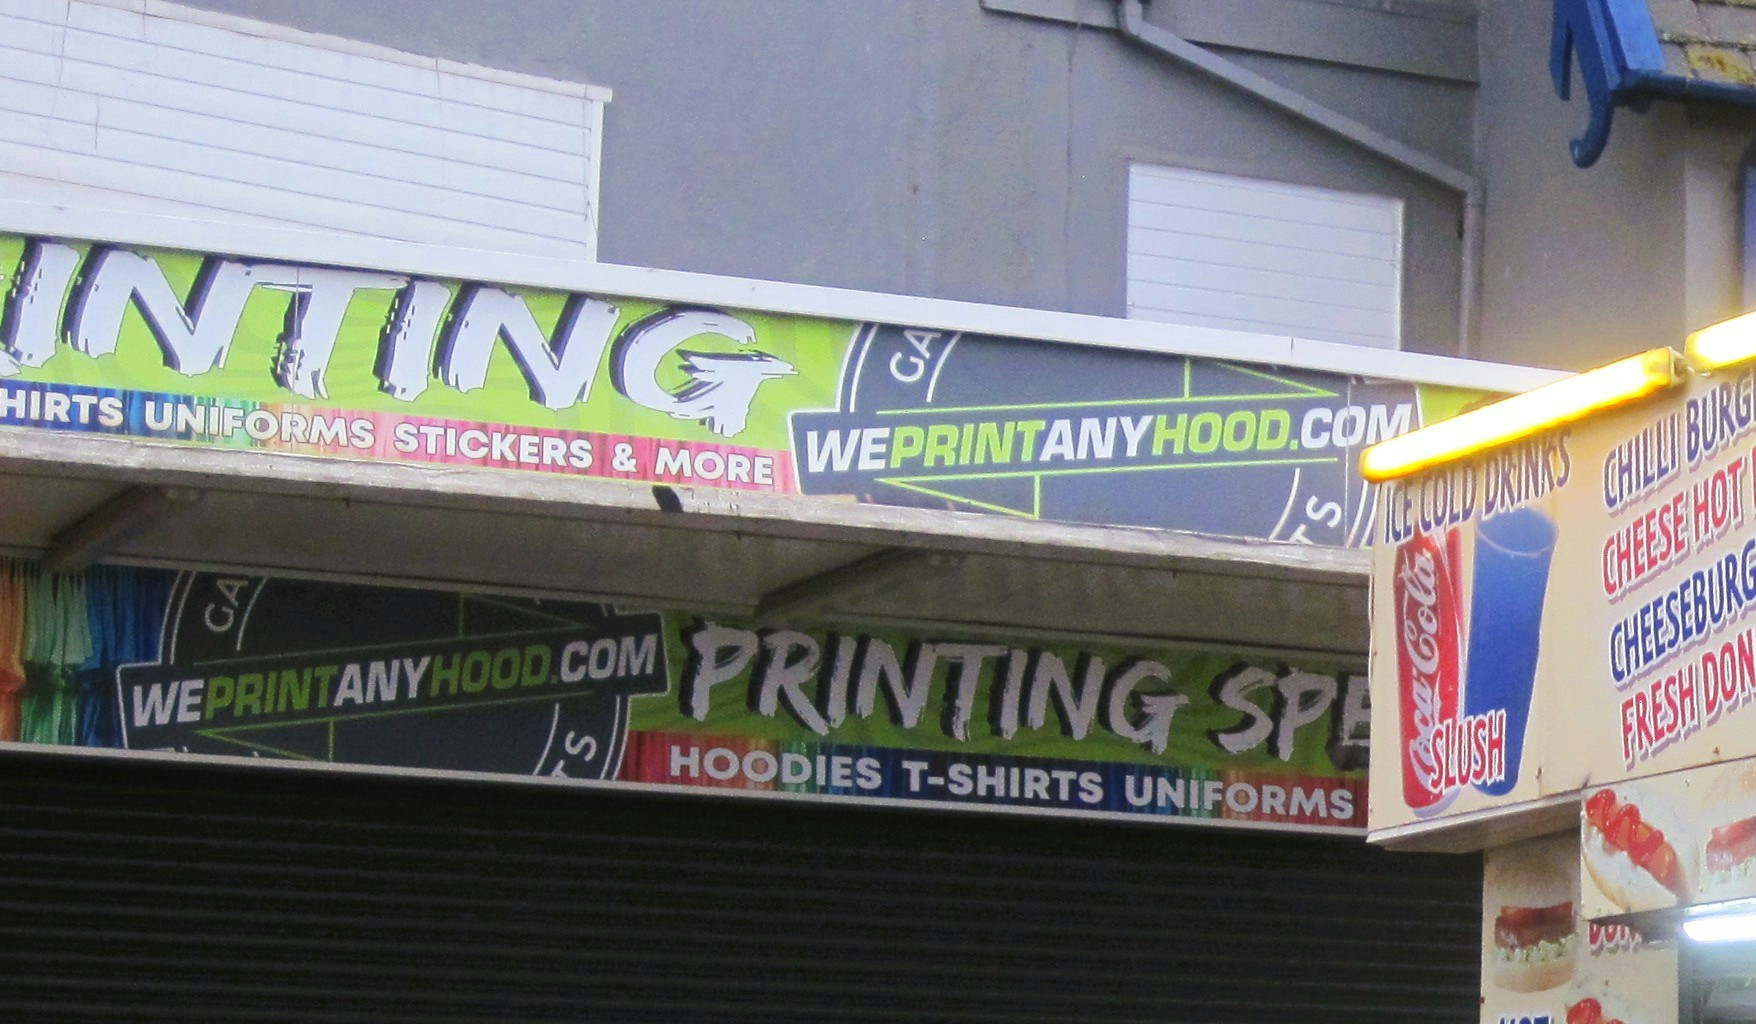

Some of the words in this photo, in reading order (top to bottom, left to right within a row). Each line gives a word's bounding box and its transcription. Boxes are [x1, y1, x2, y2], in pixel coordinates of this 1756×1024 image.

[0, 237, 797, 437] INTING
[145, 401, 376, 450] UNIFORMS
[394, 425, 593, 470] STICKERS
[612, 443, 638, 472] &
[654, 449, 775, 485] MORE
[805, 403, 1411, 474] WEPRINTANYHOOD.COM
[1384, 482, 1414, 545] ICE
[1418, 460, 1477, 533] COLD
[1483, 427, 1571, 517] DRINKS
[1603, 413, 1680, 508] CHILLI
[1602, 498, 1688, 597] CHEESE
[1693, 460, 1747, 540] HOT
[132, 634, 658, 728] WEPRINTANYHOOD.COM
[690, 619, 1189, 756] PRINTING
[1621, 665, 1697, 763] FRESH
[670, 746, 882, 790] HOODIES
[902, 760, 1103, 803] T-SHIRTS
[1125, 776, 1355, 820] UNIFORMS
[1429, 708, 1507, 796] SLUSH
